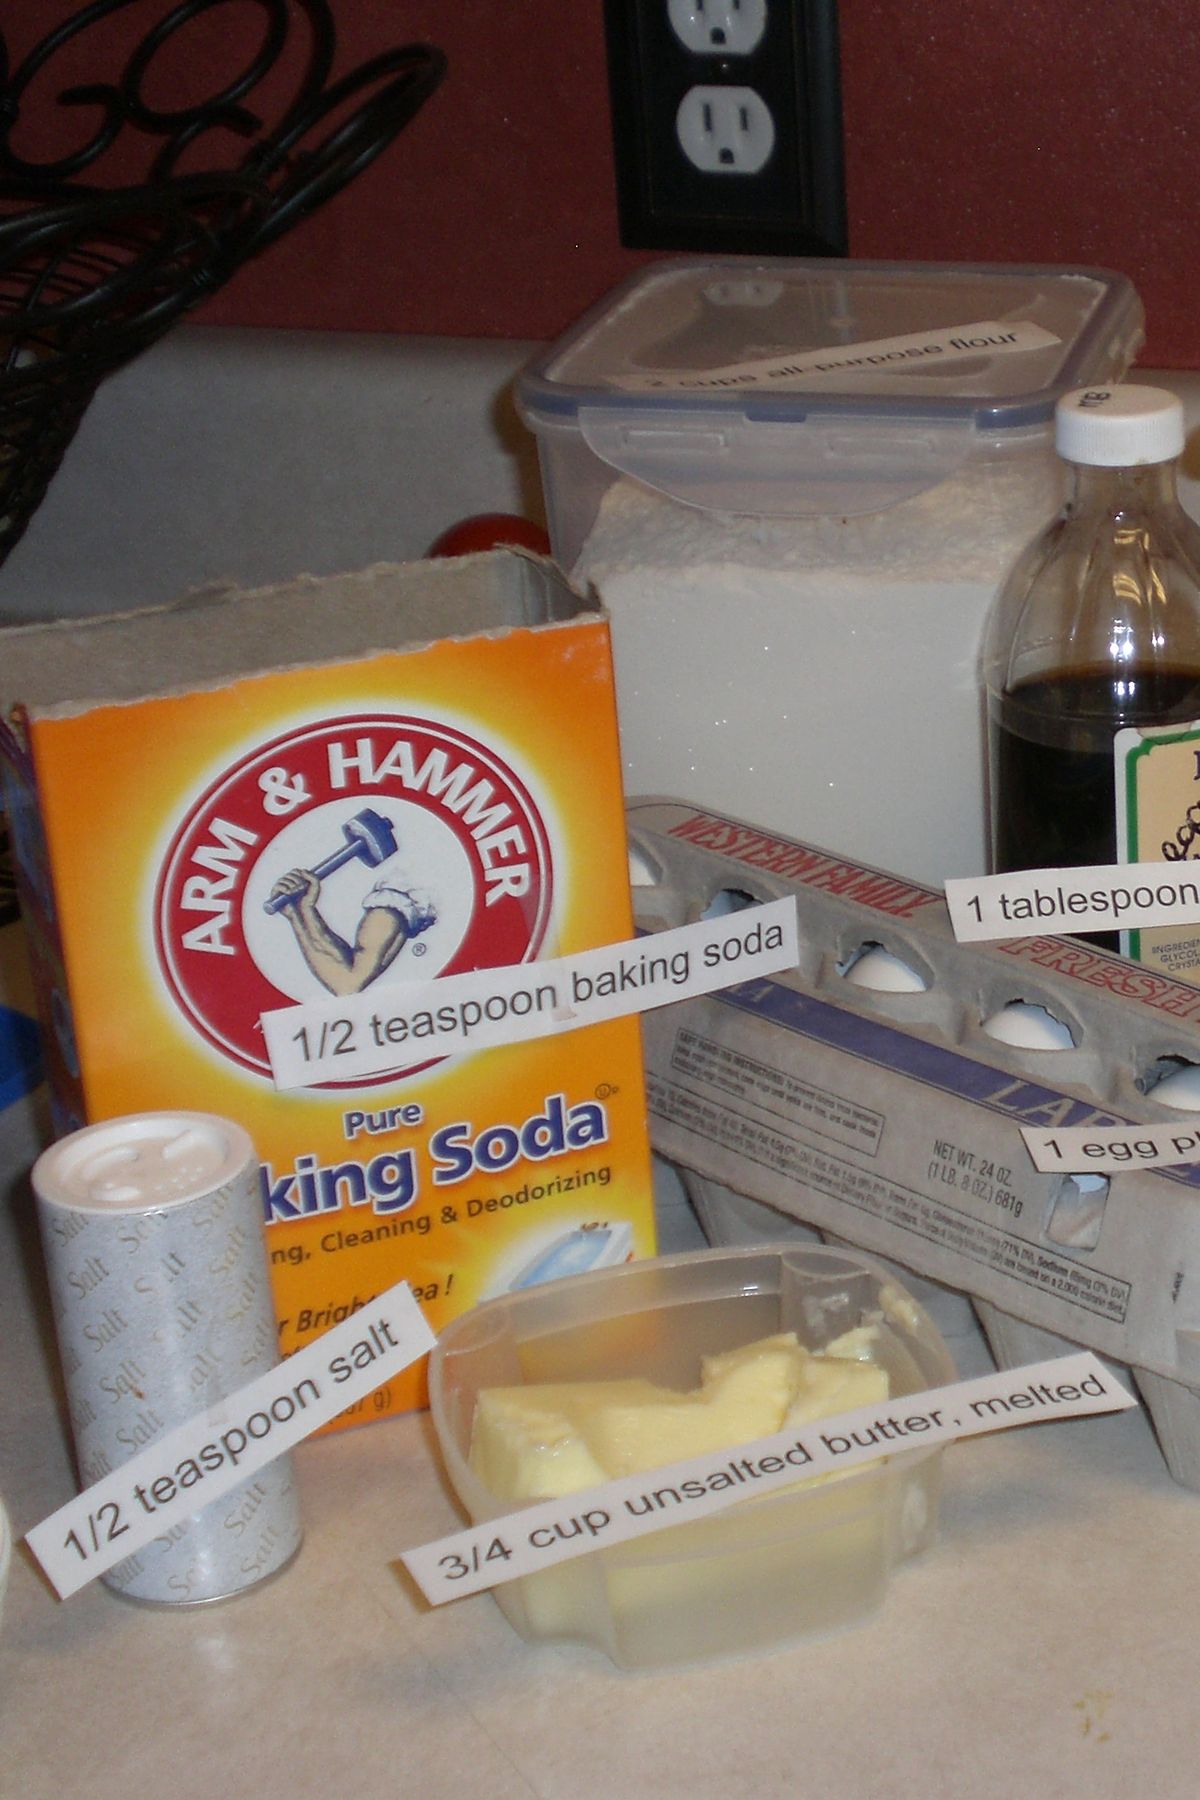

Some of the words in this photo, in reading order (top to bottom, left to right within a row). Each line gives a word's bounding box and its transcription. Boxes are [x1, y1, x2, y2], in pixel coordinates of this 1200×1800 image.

[768, 364, 804, 378] all
[814, 343, 944, 372] purpose
[949, 331, 1019, 351] flour
[180, 816, 259, 956] ARM
[257, 765, 312, 817] &
[328, 737, 531, 907] HAMMER
[667, 814, 825, 884] WESTERN
[814, 862, 946, 918] FAMILY
[966, 895, 985, 923] 1
[1000, 876, 1200, 921] tablespoon
[292, 1018, 357, 1062] 1/2
[370, 983, 558, 1047] teaspoon
[571, 951, 690, 1003] baking
[703, 923, 783, 968] soda
[344, 1103, 423, 1140] Pure
[261, 1147, 414, 1222] king
[430, 1095, 607, 1184] Soda
[933, 1138, 957, 1162] NET
[979, 1159, 995, 1178] 24
[1043, 1138, 1063, 1159] 1
[1082, 1140, 1159, 1162] egg
[320, 1214, 432, 1252] Cleaning
[440, 1205, 459, 1224] &
[466, 1166, 612, 1218] Deodorizing
[995, 1188, 1024, 1219] 681g
[67, 1256, 110, 1300] Salt
[83, 1309, 128, 1352] Salt
[101, 1360, 145, 1404] Salt
[63, 1502, 131, 1562] 1/2
[133, 1378, 321, 1513] teaspoon
[328, 1318, 399, 1384] salt
[115, 1410, 164, 1455] Salt
[437, 1536, 513, 1581] 3/4
[528, 1508, 611, 1550] cup
[623, 1441, 813, 1517] unsalted
[820, 1405, 961, 1456] butter,
[969, 1372, 1107, 1420] melted
